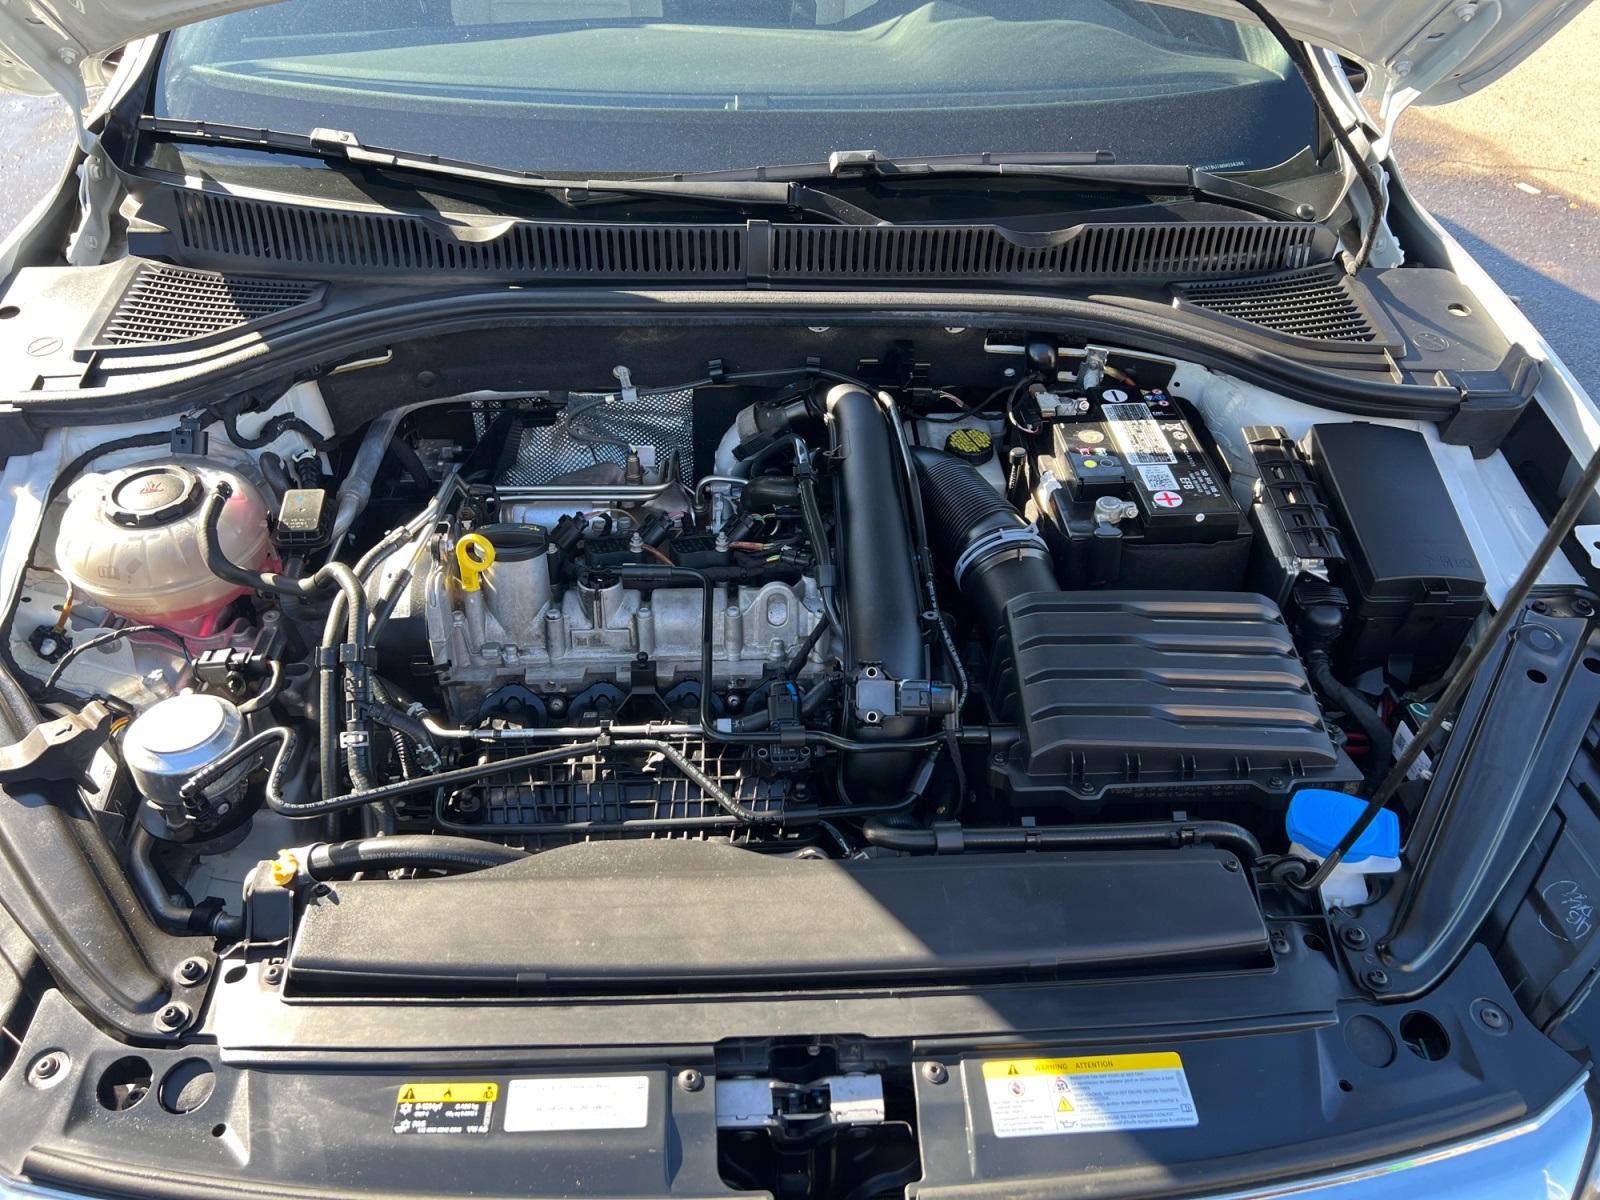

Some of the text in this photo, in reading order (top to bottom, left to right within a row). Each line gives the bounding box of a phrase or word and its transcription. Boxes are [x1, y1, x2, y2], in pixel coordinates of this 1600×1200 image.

[1179, 478, 1195, 489] EFB
[1033, 1060, 1113, 1071] WARNING ATTENTION
